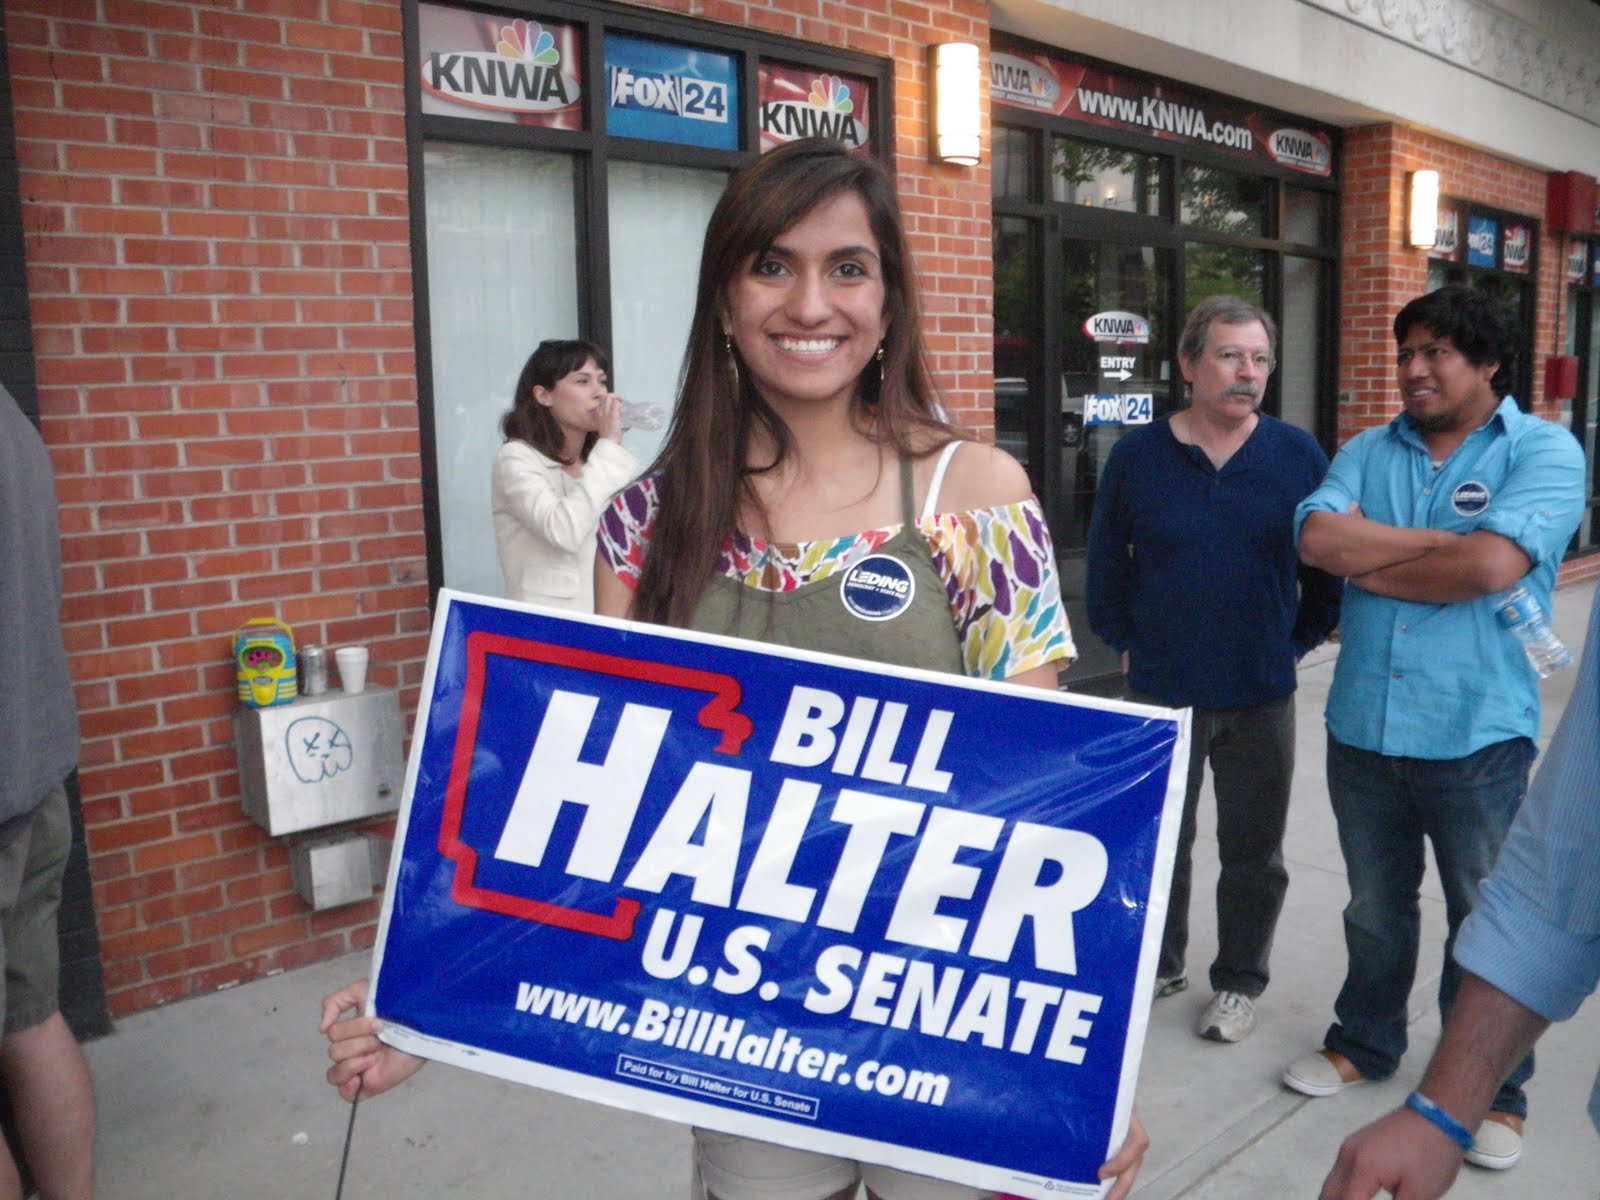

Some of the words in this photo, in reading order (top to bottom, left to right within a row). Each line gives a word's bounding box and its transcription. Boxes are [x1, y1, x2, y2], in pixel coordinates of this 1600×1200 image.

[431, 53, 569, 104] KNWA
[614, 70, 678, 112] FOX
[687, 83, 725, 118] 24
[991, 63, 1032, 93] NWA
[763, 102, 859, 146] KNWA
[1077, 87, 1252, 150] www.KNWA.com
[1276, 134, 1313, 160] KNWA
[1094, 318, 1135, 334] KNWA
[1100, 356, 1136, 369] ENTRY
[1086, 396, 1123, 423] FOX
[1127, 397, 1151, 420] 24
[849, 569, 909, 593] LEDING
[770, 686, 954, 793] BILL
[494, 690, 1108, 975] HALTER
[642, 909, 779, 1000] U.S.
[804, 945, 1102, 1064] SENATE
[516, 983, 950, 1105] www.BillHalter.com
[623, 1060, 647, 1075] Paid
[649, 1067, 663, 1079] for
[665, 1070, 679, 1084] by
[680, 1074, 699, 1087] Bill
[700, 1078, 731, 1096] Halter
[733, 1086, 749, 1099] for
[751, 1090, 772, 1105] U.S.
[774, 1096, 811, 1113] Senate
